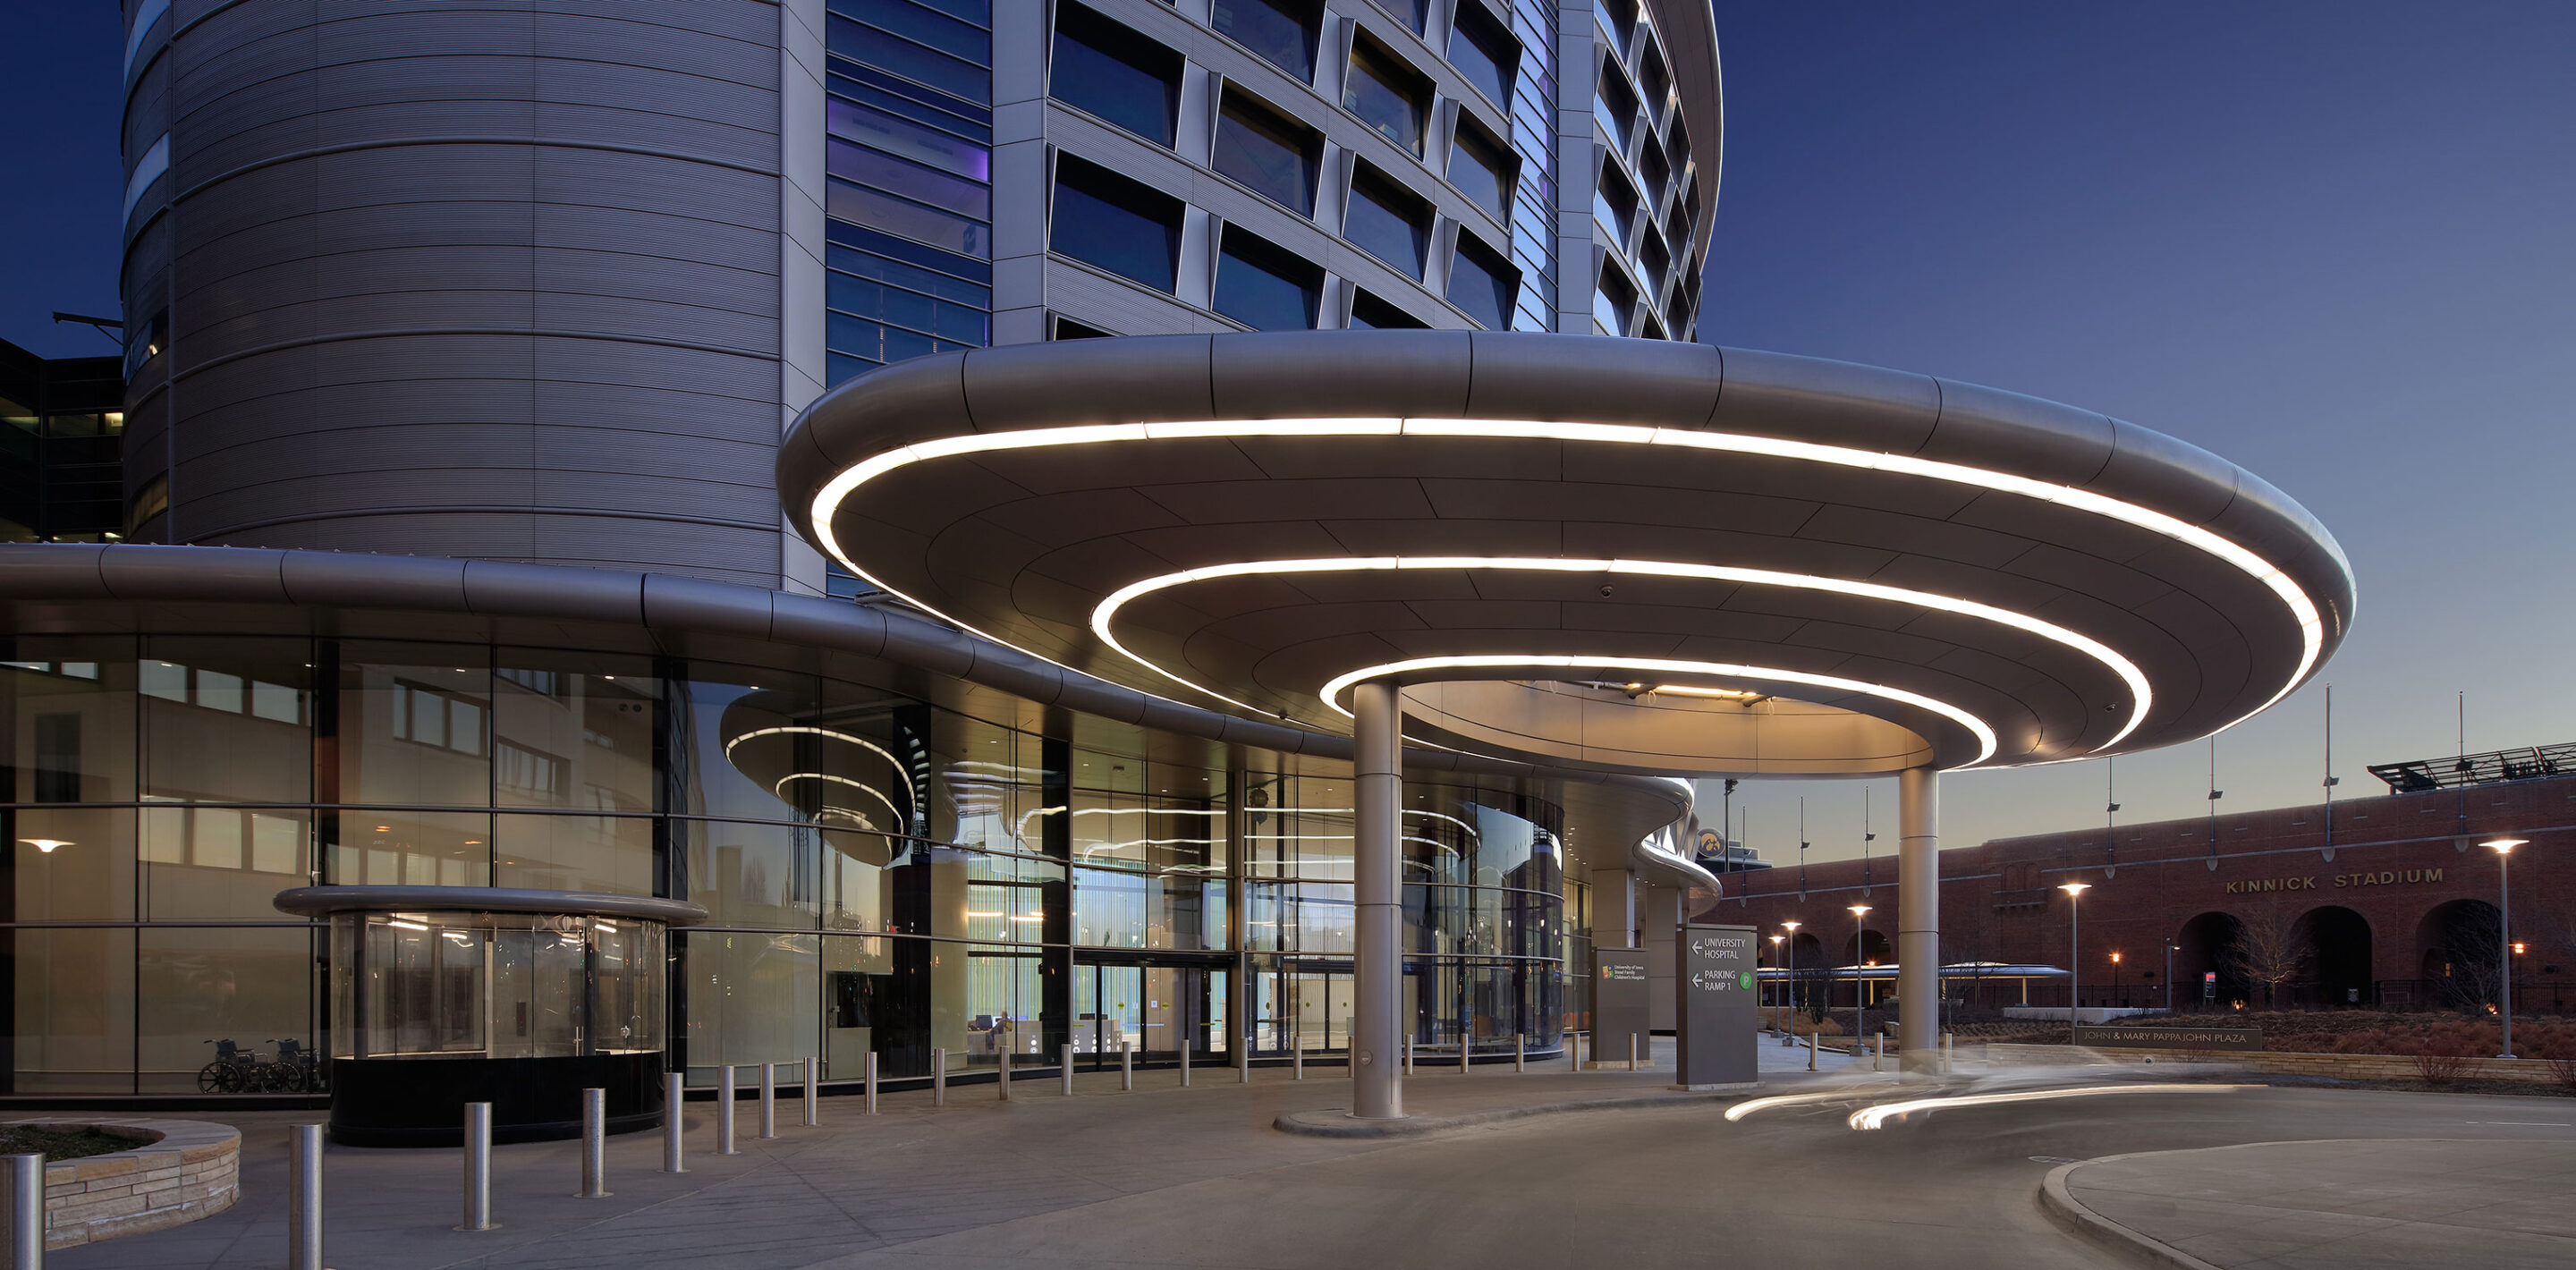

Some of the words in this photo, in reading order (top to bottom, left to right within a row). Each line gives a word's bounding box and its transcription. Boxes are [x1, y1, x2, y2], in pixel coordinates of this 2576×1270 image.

[2226, 876, 2317, 893] KINNICK
[2334, 868, 2444, 888] STADIUM
[1704, 937, 1746, 948] UNIVERSITY
[1704, 950, 1739, 960] HOSPITAL
[1704, 970, 1736, 979] PARKING
[1705, 982, 1726, 991] RAMP
[1726, 983, 1731, 991] 1
[2084, 1031, 2111, 1040] JOHN
[2113, 1032, 2121, 1040] &
[2123, 1032, 2149, 1041] MARY
[2153, 1032, 2212, 1043] PAPPAJOHN
[2214, 1034, 2247, 1043] PLAZA
